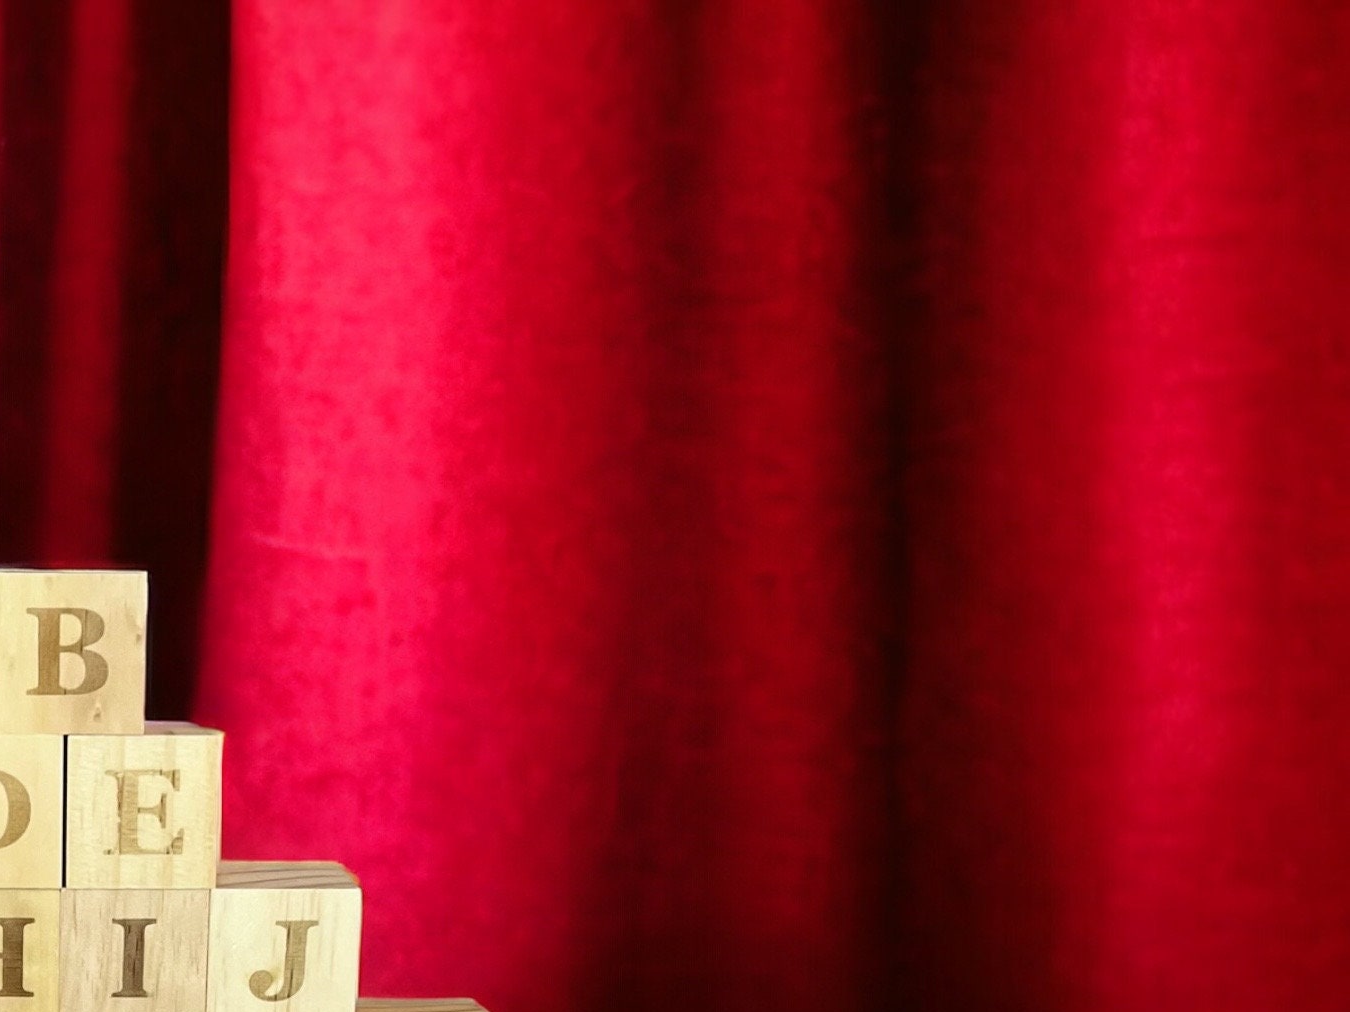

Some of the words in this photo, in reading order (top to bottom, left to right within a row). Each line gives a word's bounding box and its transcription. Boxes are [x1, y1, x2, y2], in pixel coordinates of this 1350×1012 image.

[26, 607, 109, 696] B
[105, 769, 184, 856] E
[111, 918, 158, 998] I
[249, 920, 319, 1001] J
